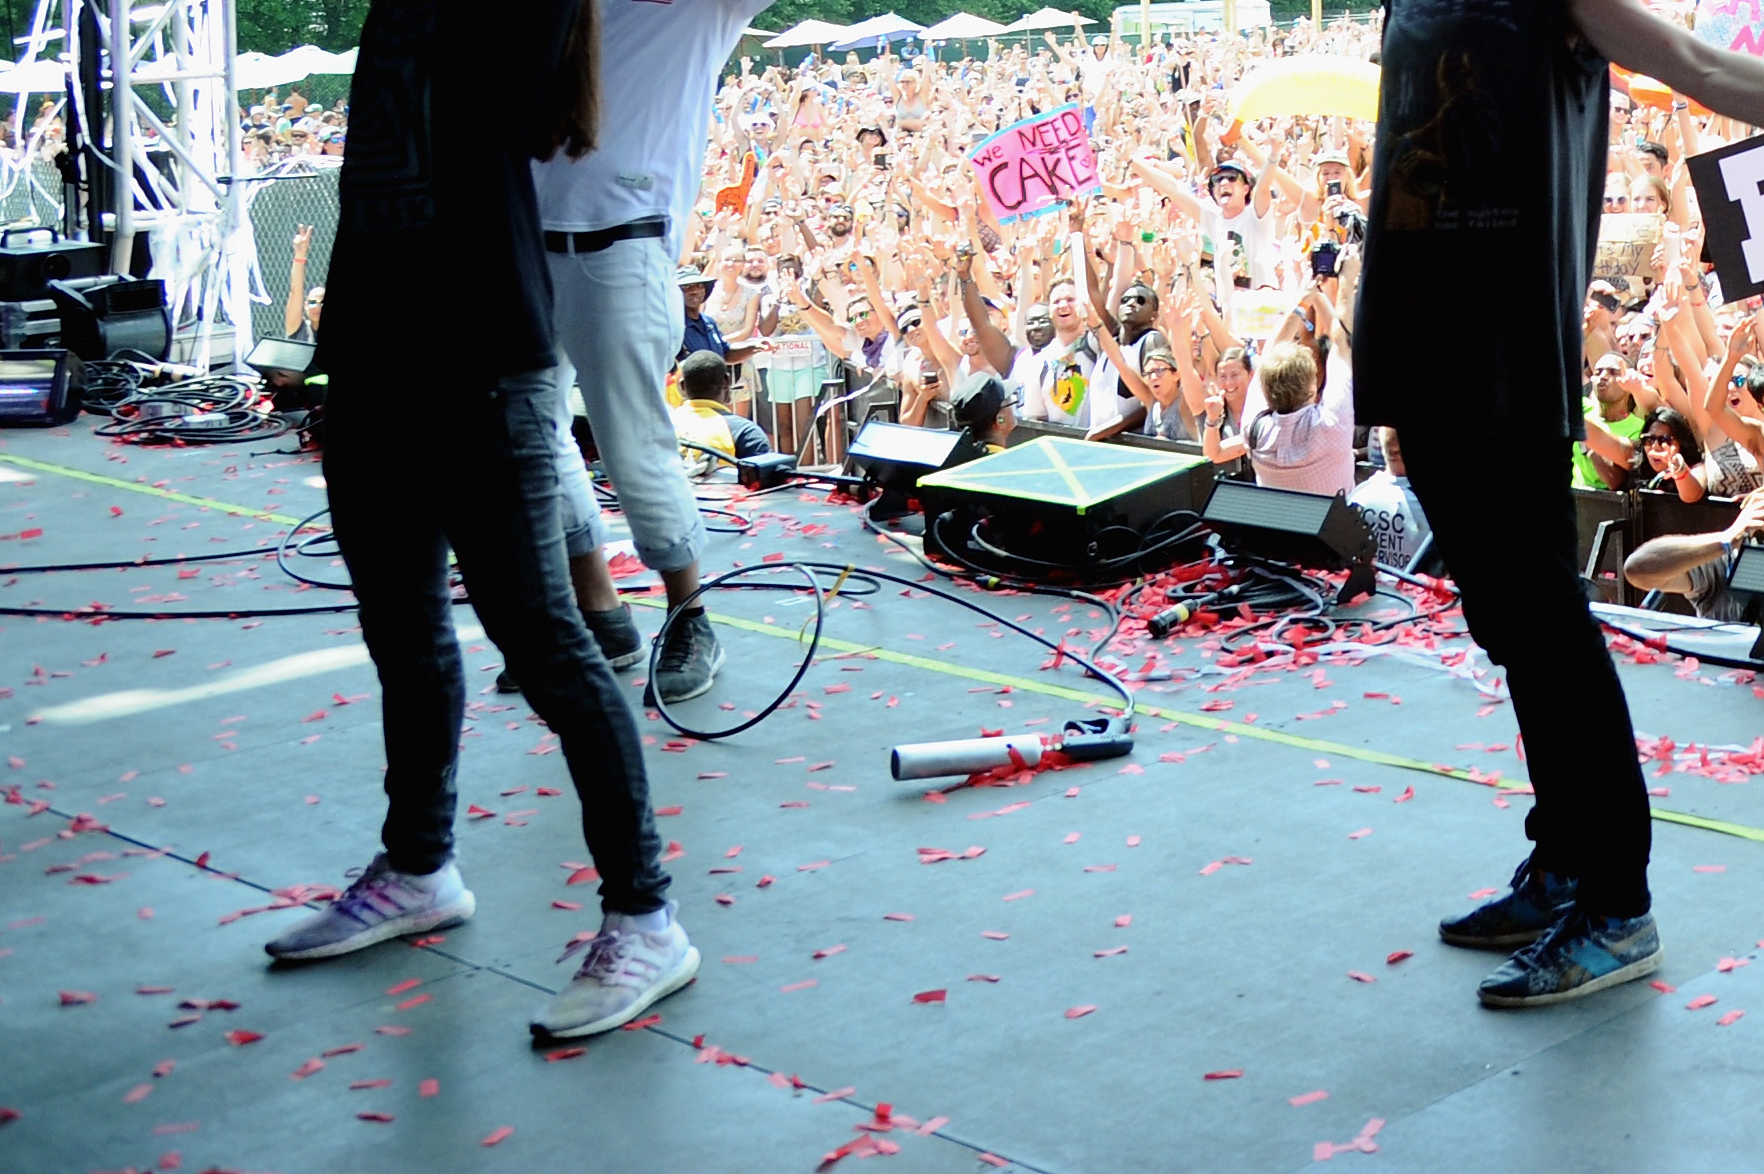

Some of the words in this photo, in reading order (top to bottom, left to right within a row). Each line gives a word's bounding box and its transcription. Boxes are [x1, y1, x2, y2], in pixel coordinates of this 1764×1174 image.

[1017, 111, 1081, 151] NEED
[989, 143, 1093, 210] CAKE
[1362, 508, 1405, 534] CSC
[1372, 532, 1404, 552] VENT
